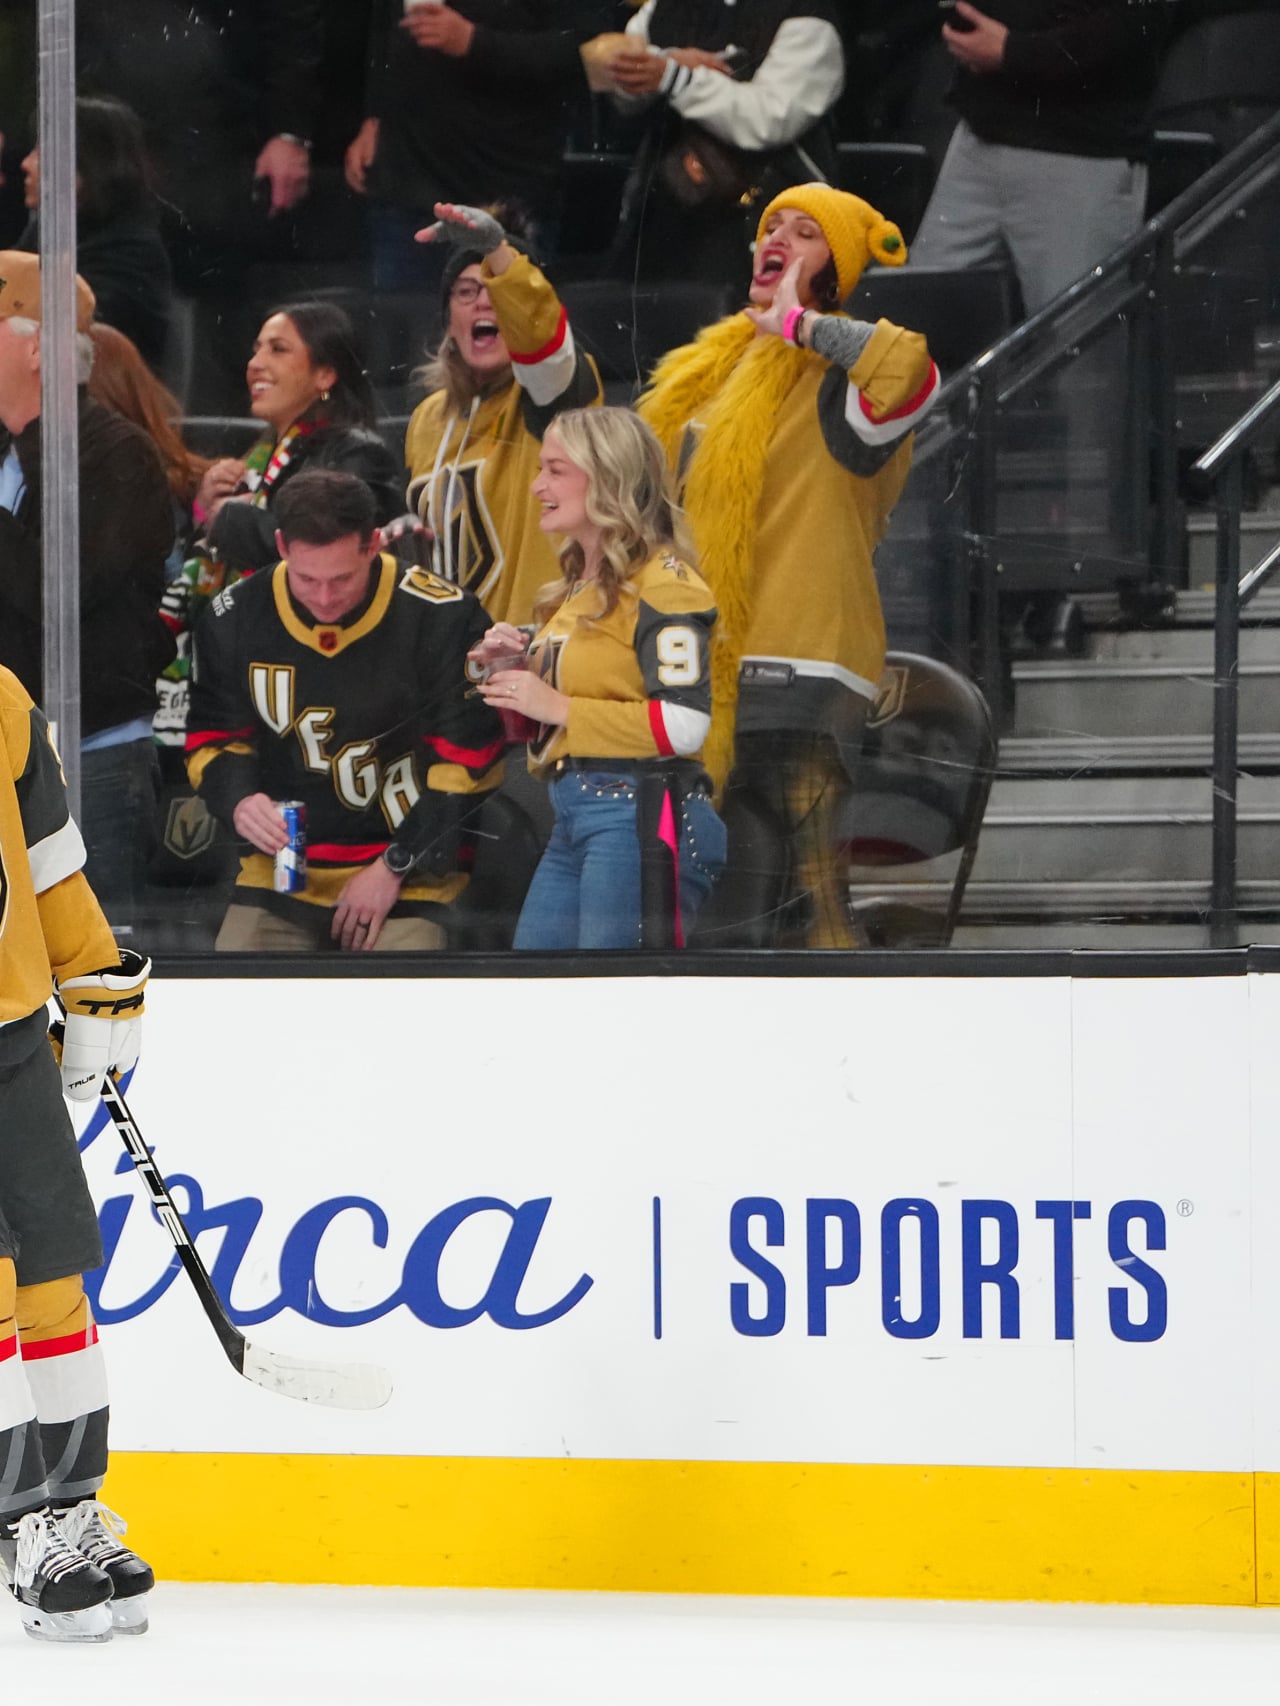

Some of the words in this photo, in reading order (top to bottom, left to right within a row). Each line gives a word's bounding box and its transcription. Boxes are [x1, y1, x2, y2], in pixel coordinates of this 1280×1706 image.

[656, 625, 704, 687] 9
[76, 991, 145, 1016] TR
[67, 1072, 97, 1091] TRUE
[101, 1073, 191, 1247] TRUE
[729, 1196, 1169, 1343] SPORTS
